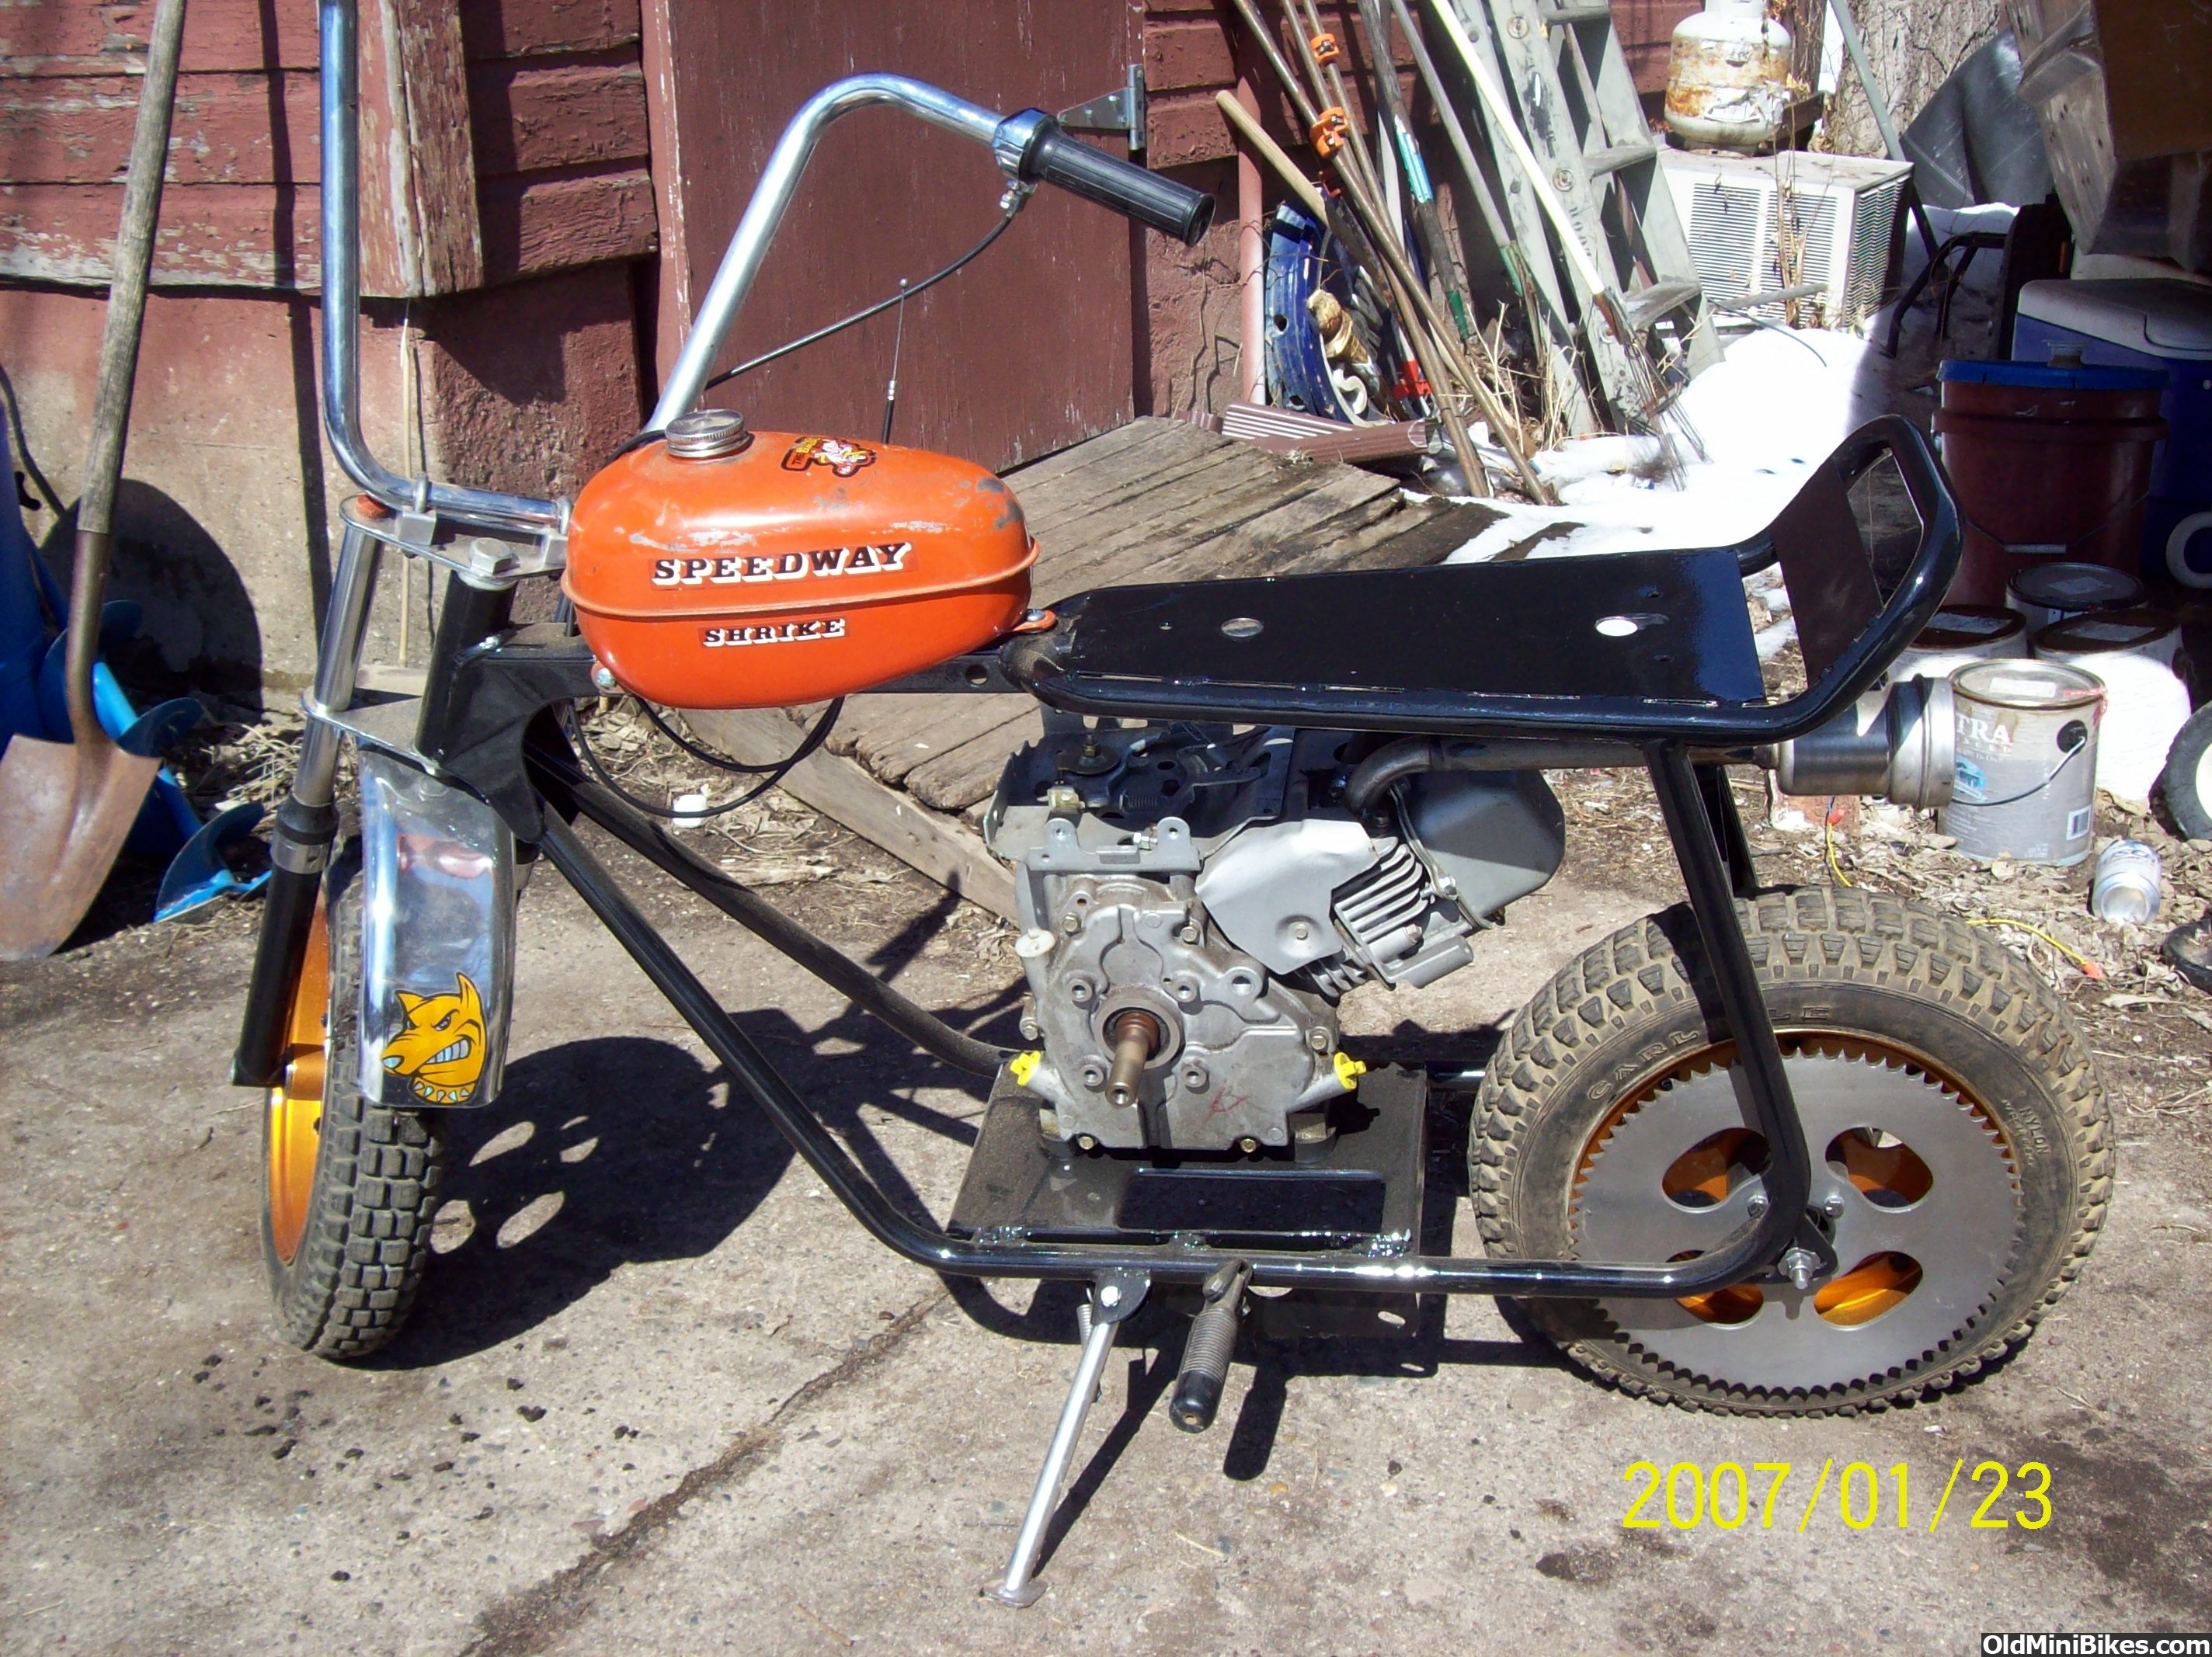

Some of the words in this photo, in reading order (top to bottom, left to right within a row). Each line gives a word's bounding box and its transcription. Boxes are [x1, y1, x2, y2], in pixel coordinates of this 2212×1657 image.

[652, 541, 912, 585] SPEEDWAY
[703, 618, 846, 648] SHRIKE
[1956, 713, 2013, 746] TRA
[2019, 1106, 2051, 1155] NYLON
